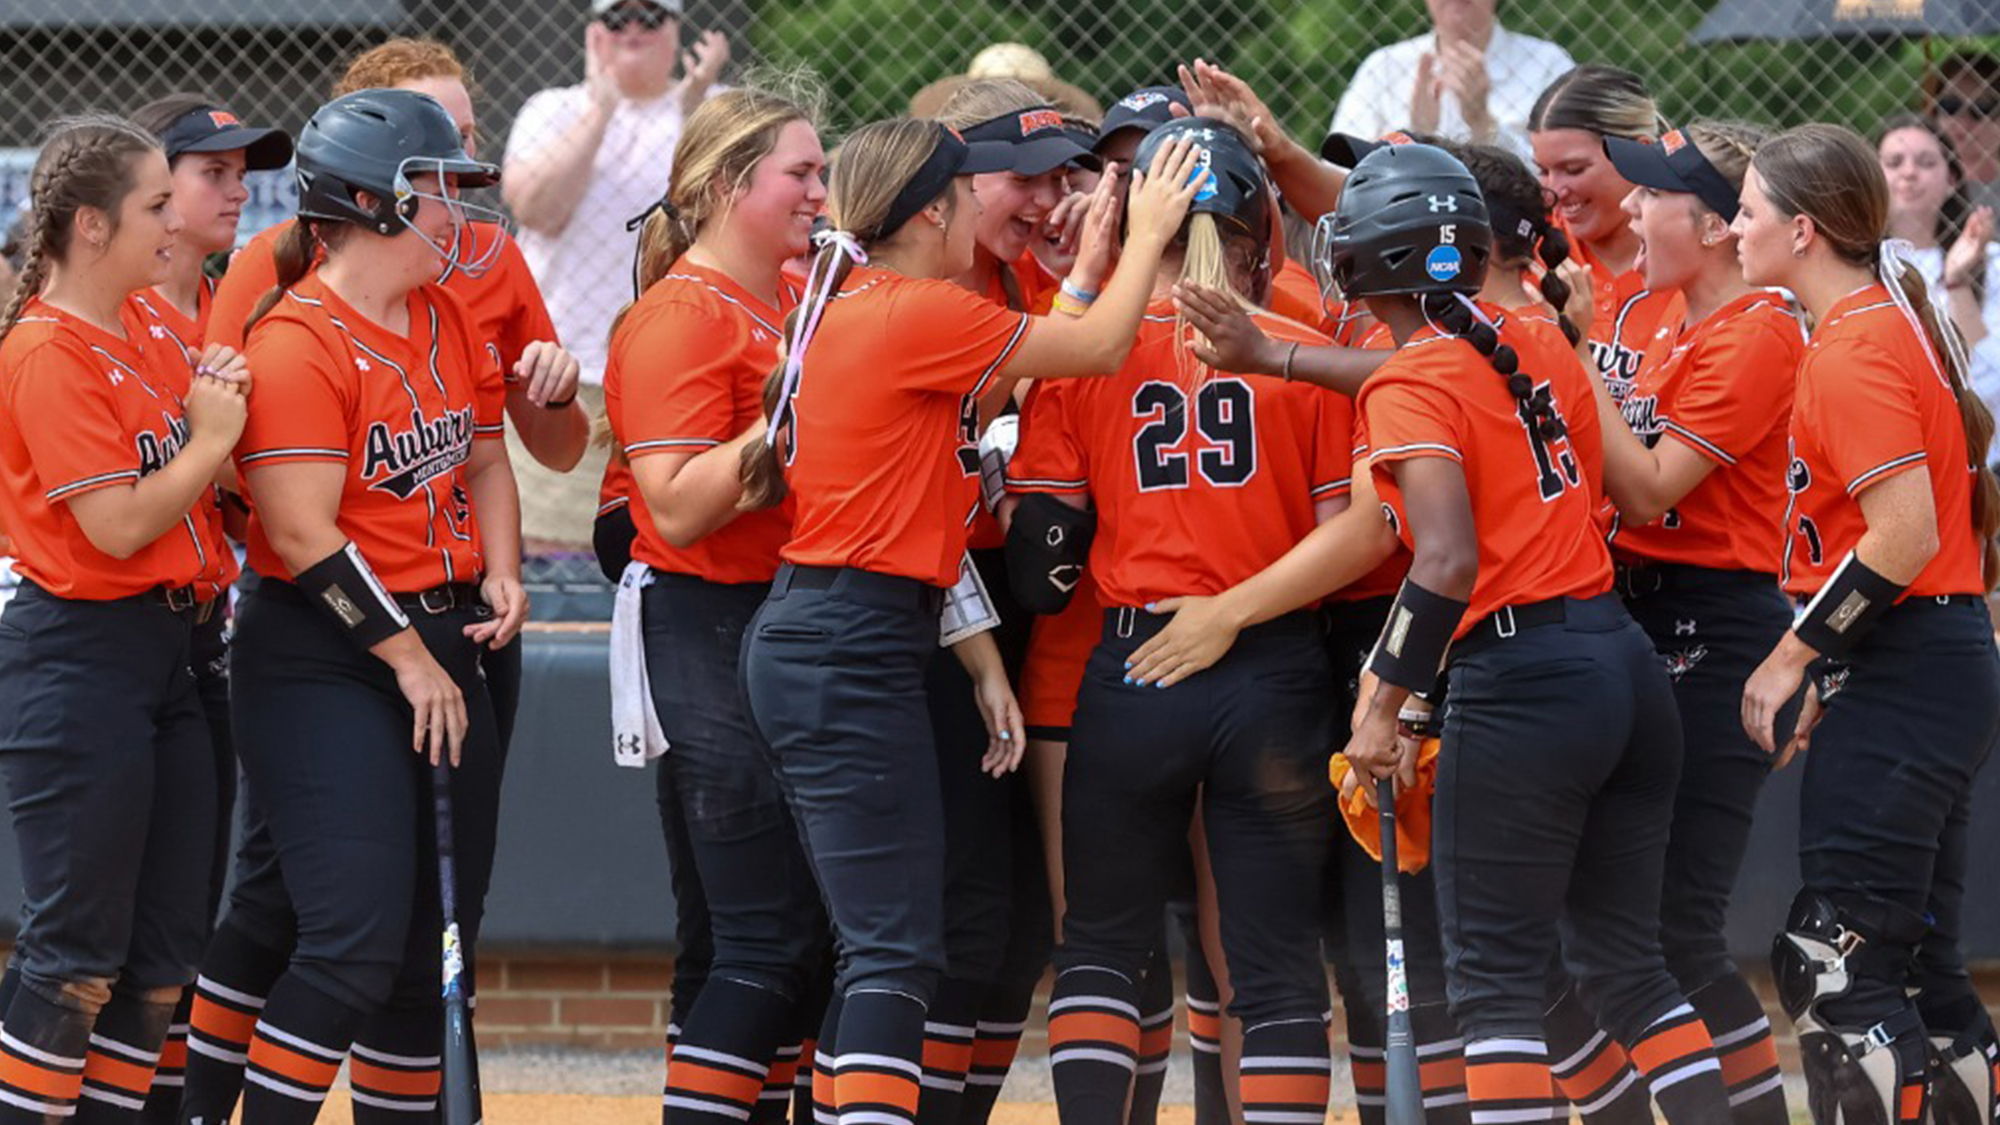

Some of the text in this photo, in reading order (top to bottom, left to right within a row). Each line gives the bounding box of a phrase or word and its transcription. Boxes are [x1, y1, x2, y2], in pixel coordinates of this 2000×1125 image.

[1439, 224, 1457, 244] 15
[1132, 377, 1257, 493] 29
[1515, 378, 1581, 503] 15
